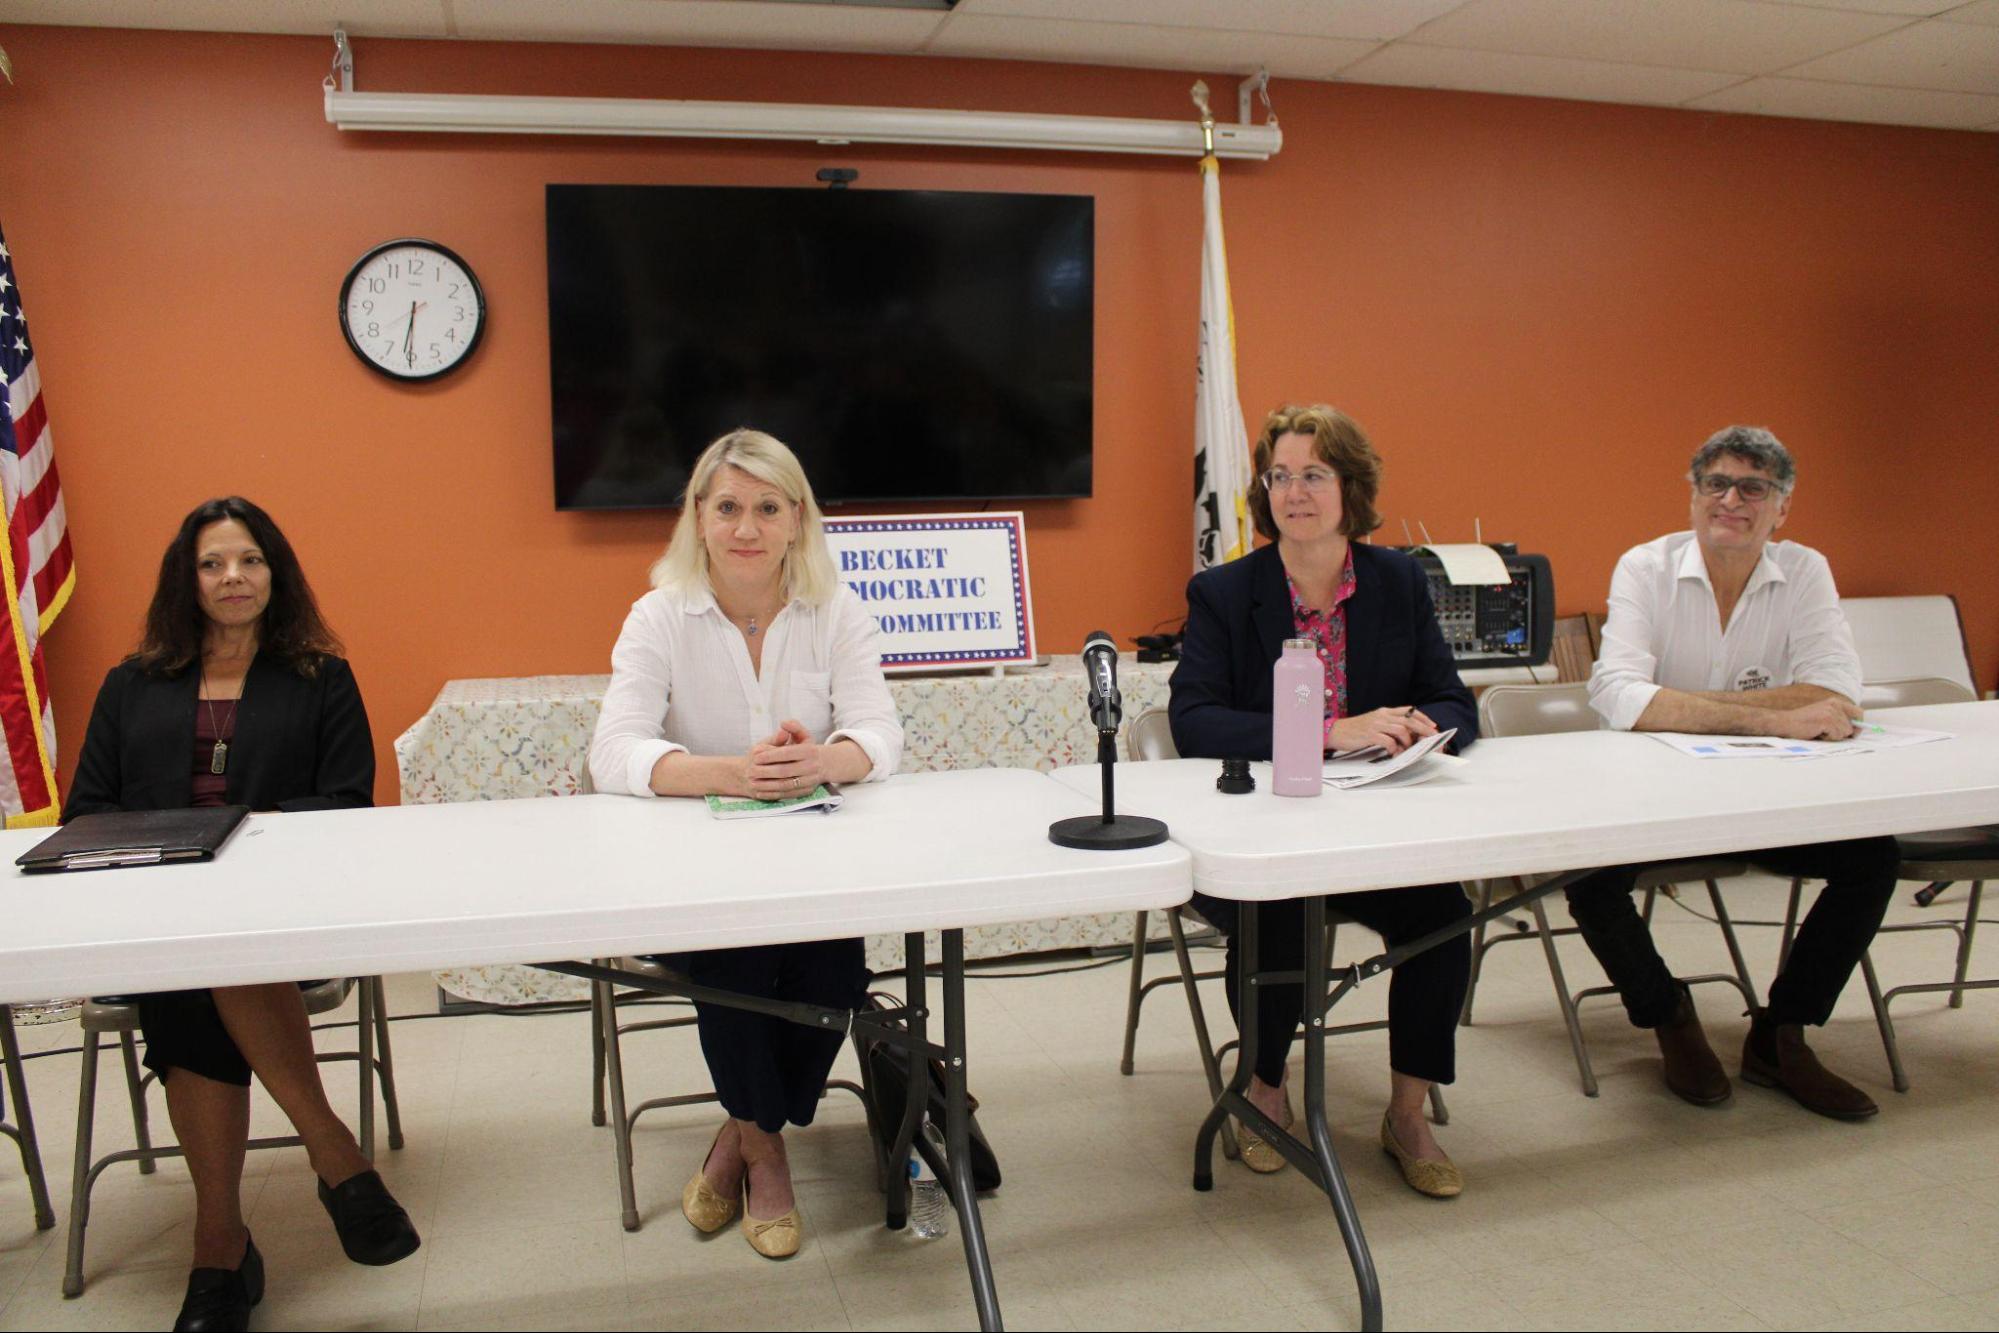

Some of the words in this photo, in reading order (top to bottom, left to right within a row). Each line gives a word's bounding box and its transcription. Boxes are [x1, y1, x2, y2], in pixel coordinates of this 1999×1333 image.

[388, 263, 399, 280] 11
[408, 259, 424, 276] 12
[436, 267, 440, 282] 1
[368, 278, 386, 294] 10
[448, 283, 460, 300] 2
[362, 300, 374, 316] 9
[453, 307, 464, 322] 3
[367, 322, 380, 338] 8
[444, 328, 456, 344] 4
[384, 340, 395, 356] 7
[405, 346, 418, 363] 6
[430, 343, 441, 359] 5
[841, 548, 948, 571] BECKET
[847, 577, 986, 601] MOCRATIC
